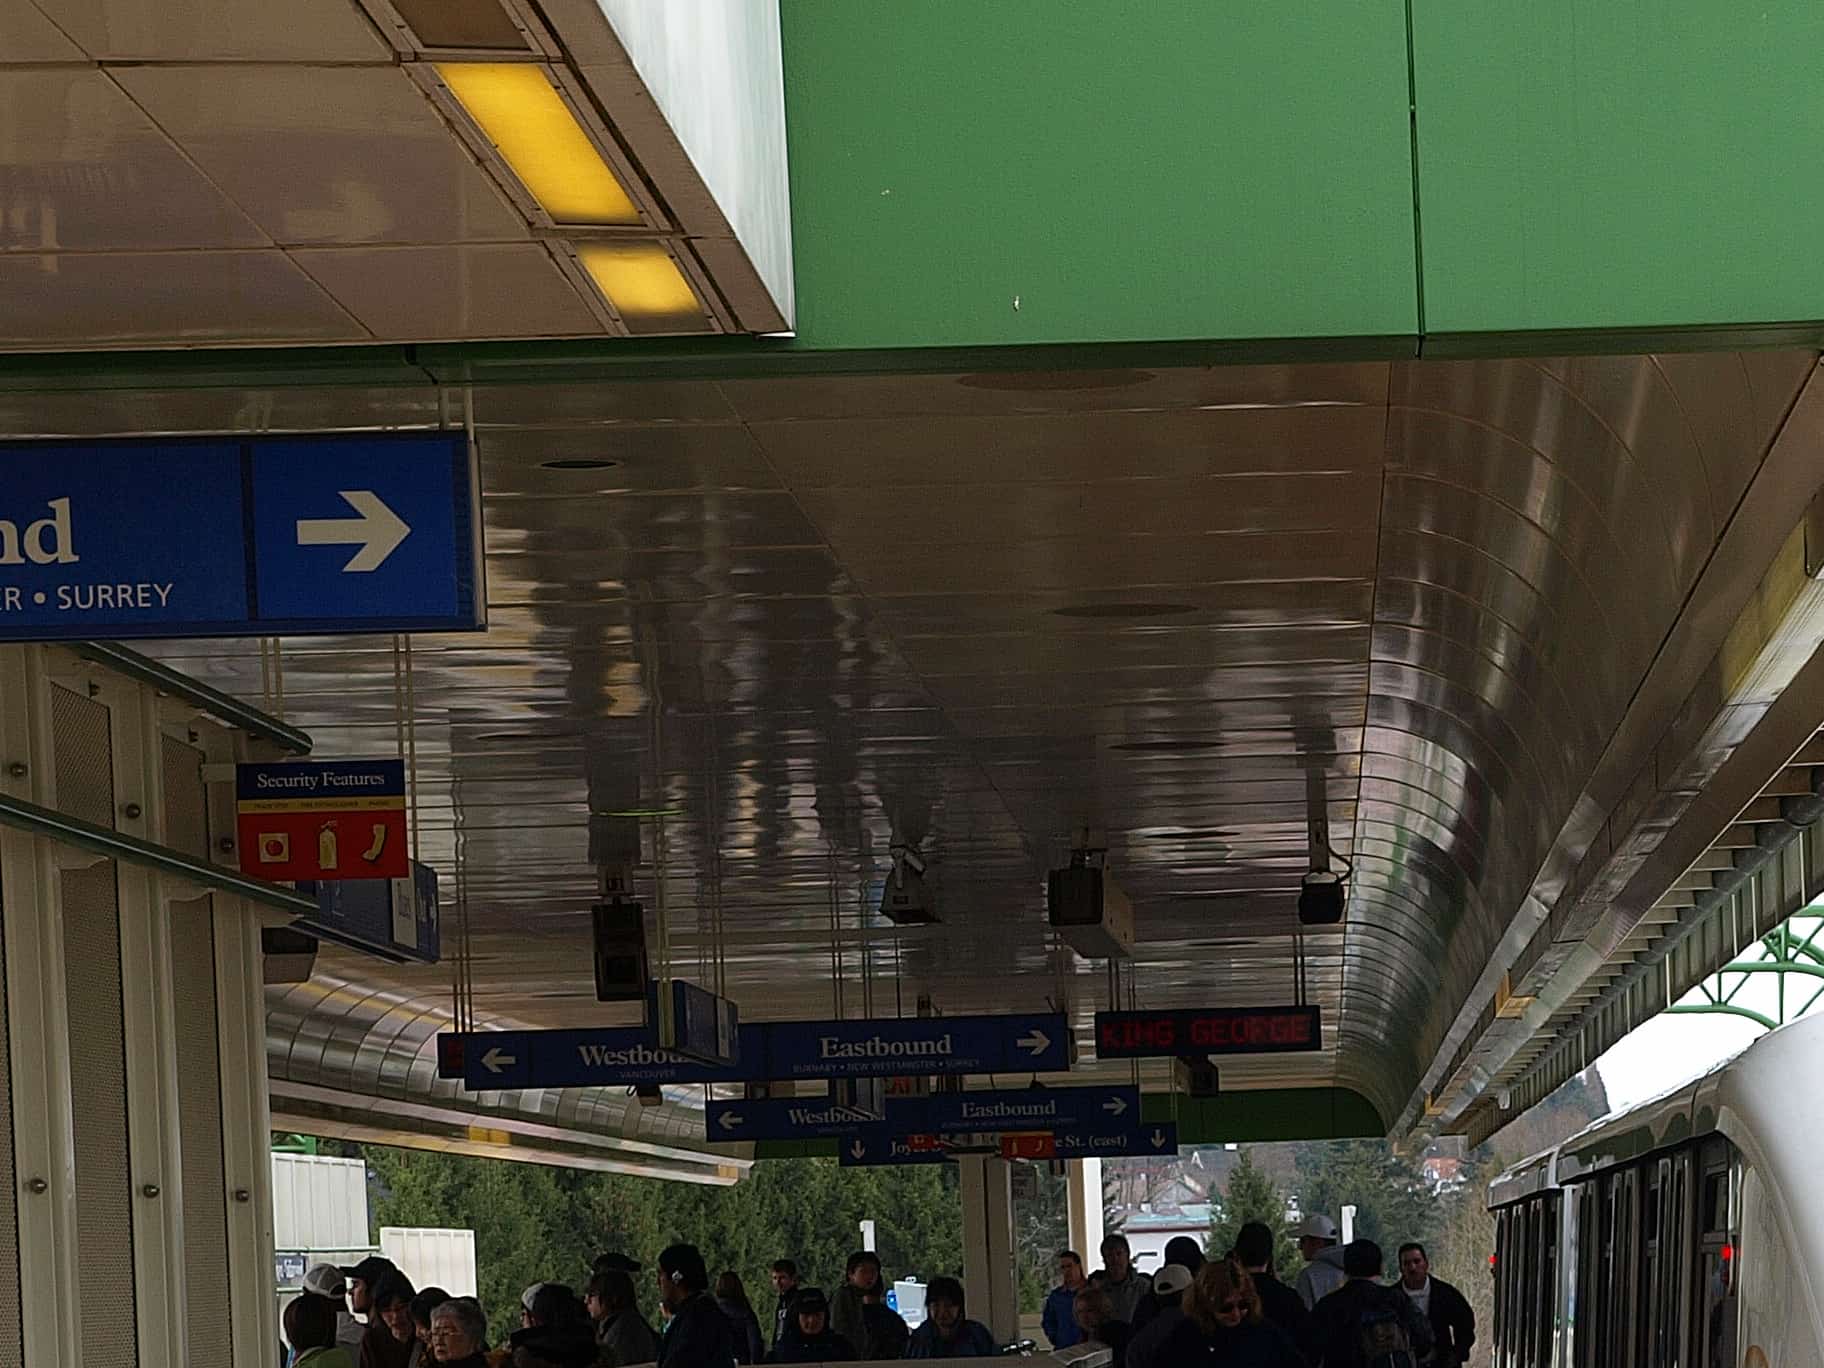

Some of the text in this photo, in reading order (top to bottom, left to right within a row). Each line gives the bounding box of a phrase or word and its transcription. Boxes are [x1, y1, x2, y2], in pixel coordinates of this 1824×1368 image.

[0, 584, 173, 611] R SURREY
[257, 772, 385, 790] Security Features
[1102, 1015, 1312, 1048] KING GEORGE
[578, 1043, 690, 1066] Westbou
[819, 1034, 952, 1057] Eastbound
[961, 1099, 1056, 1118] Eastbound
